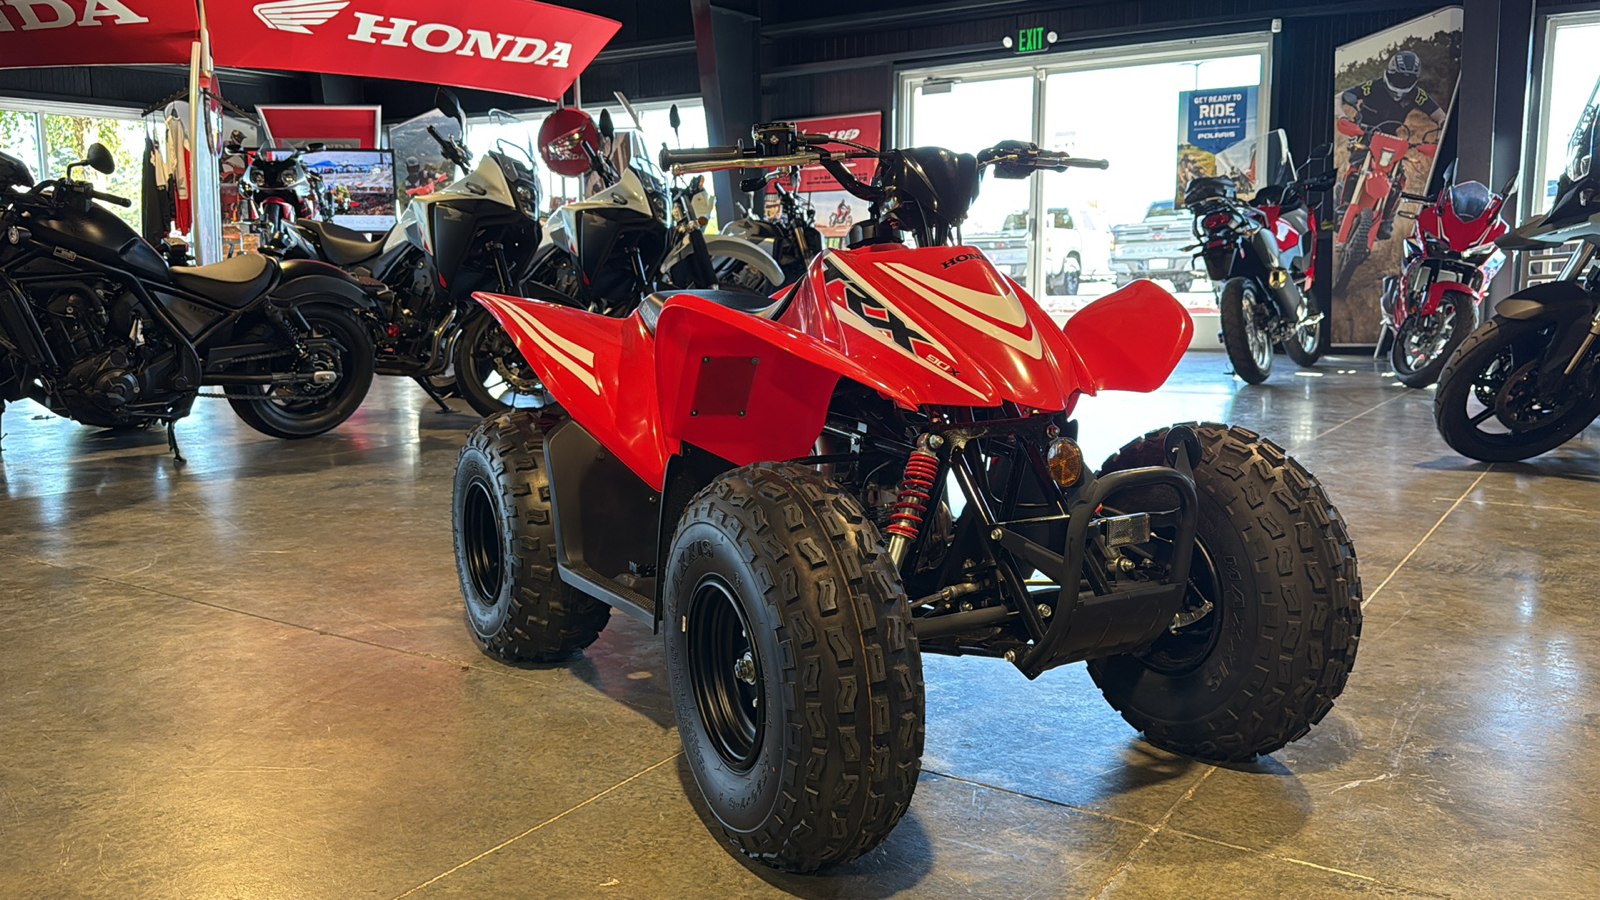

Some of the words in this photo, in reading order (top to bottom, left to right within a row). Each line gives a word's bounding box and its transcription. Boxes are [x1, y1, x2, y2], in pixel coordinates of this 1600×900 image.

[347, 11, 572, 68] HONDA
[1019, 26, 1044, 52] EXIT
[1194, 96, 1207, 104] GET
[1208, 95, 1232, 103] READY
[1199, 103, 1236, 119] RIDE
[1198, 131, 1235, 139] POLARIS
[1206, 555, 1245, 692] MAXXIS
